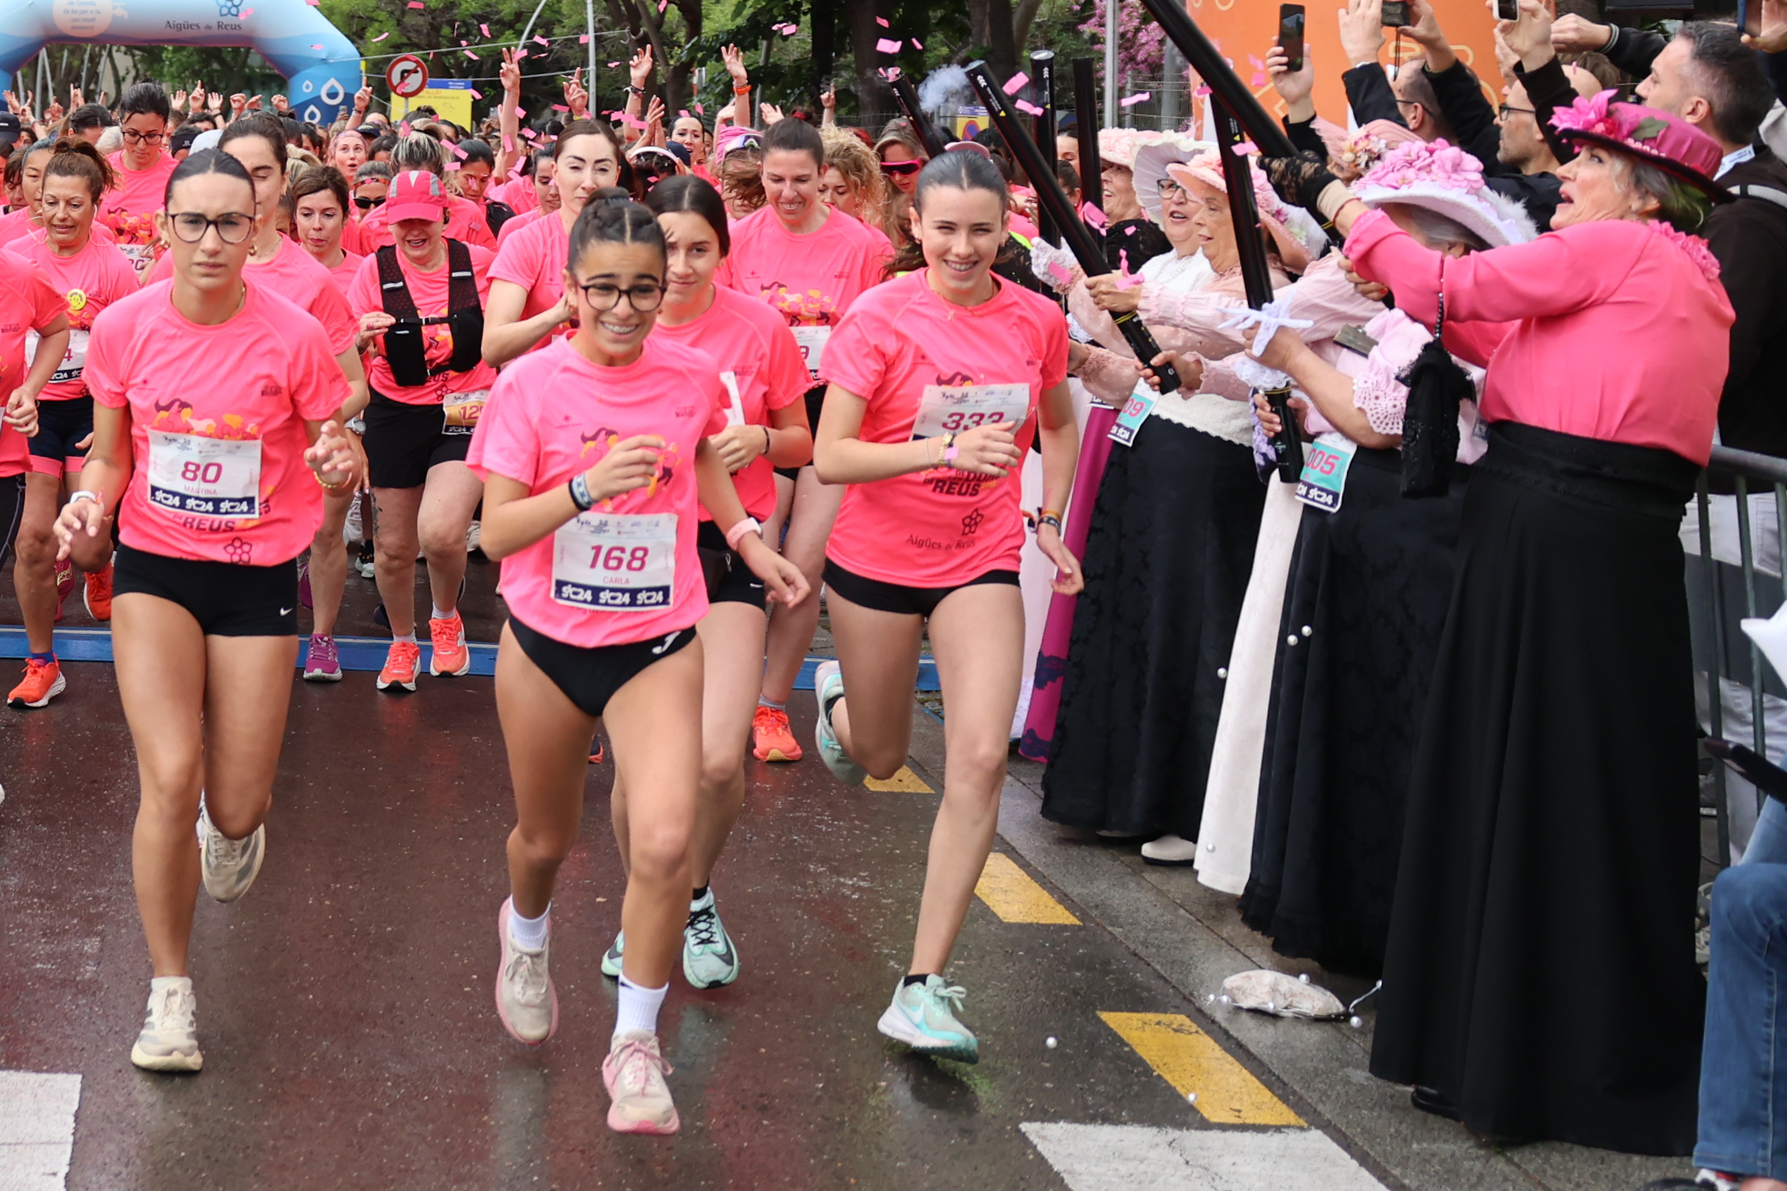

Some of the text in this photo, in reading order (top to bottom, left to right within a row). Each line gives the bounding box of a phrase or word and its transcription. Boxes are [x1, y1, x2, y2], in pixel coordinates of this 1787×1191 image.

[165, 20, 200, 32] Aigües
[217, 20, 242, 31] Reus
[181, 461, 223, 484] 80
[932, 479, 981, 497] REUS
[183, 516, 236, 532] REUS
[906, 534, 942, 550] Aigües
[955, 539, 975, 550] Reus
[589, 545, 650, 572] 168
[603, 576, 630, 585] CARLA
